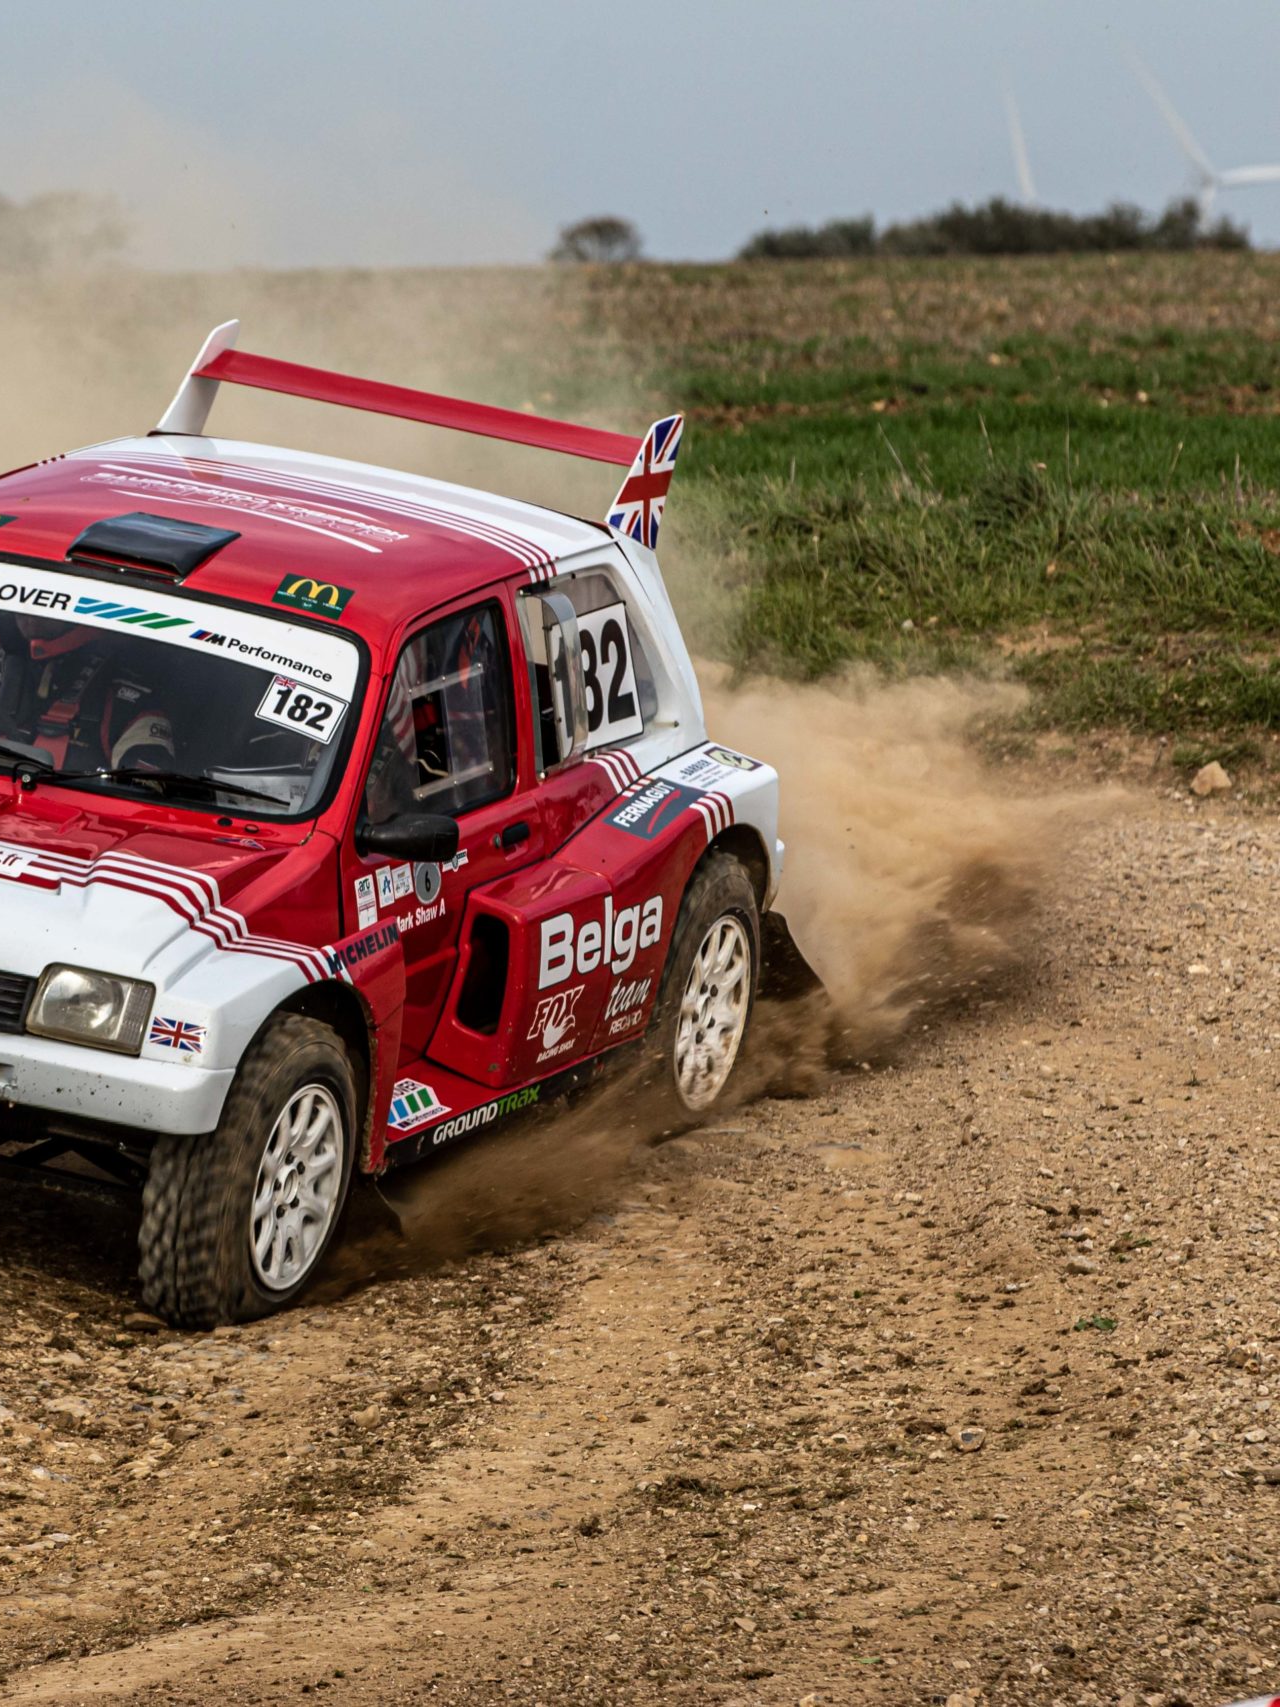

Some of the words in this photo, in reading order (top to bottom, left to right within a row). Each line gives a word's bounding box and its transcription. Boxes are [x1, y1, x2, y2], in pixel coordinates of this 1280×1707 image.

[227, 638, 333, 683] Performance
[272, 687, 334, 733] 182
[613, 781, 676, 828] FERNAGUT
[415, 904, 438, 927] Shaw
[326, 922, 399, 975] MICHELIN
[537, 894, 664, 991] Belga
[526, 984, 586, 1041] FOX
[604, 977, 652, 1021] team
